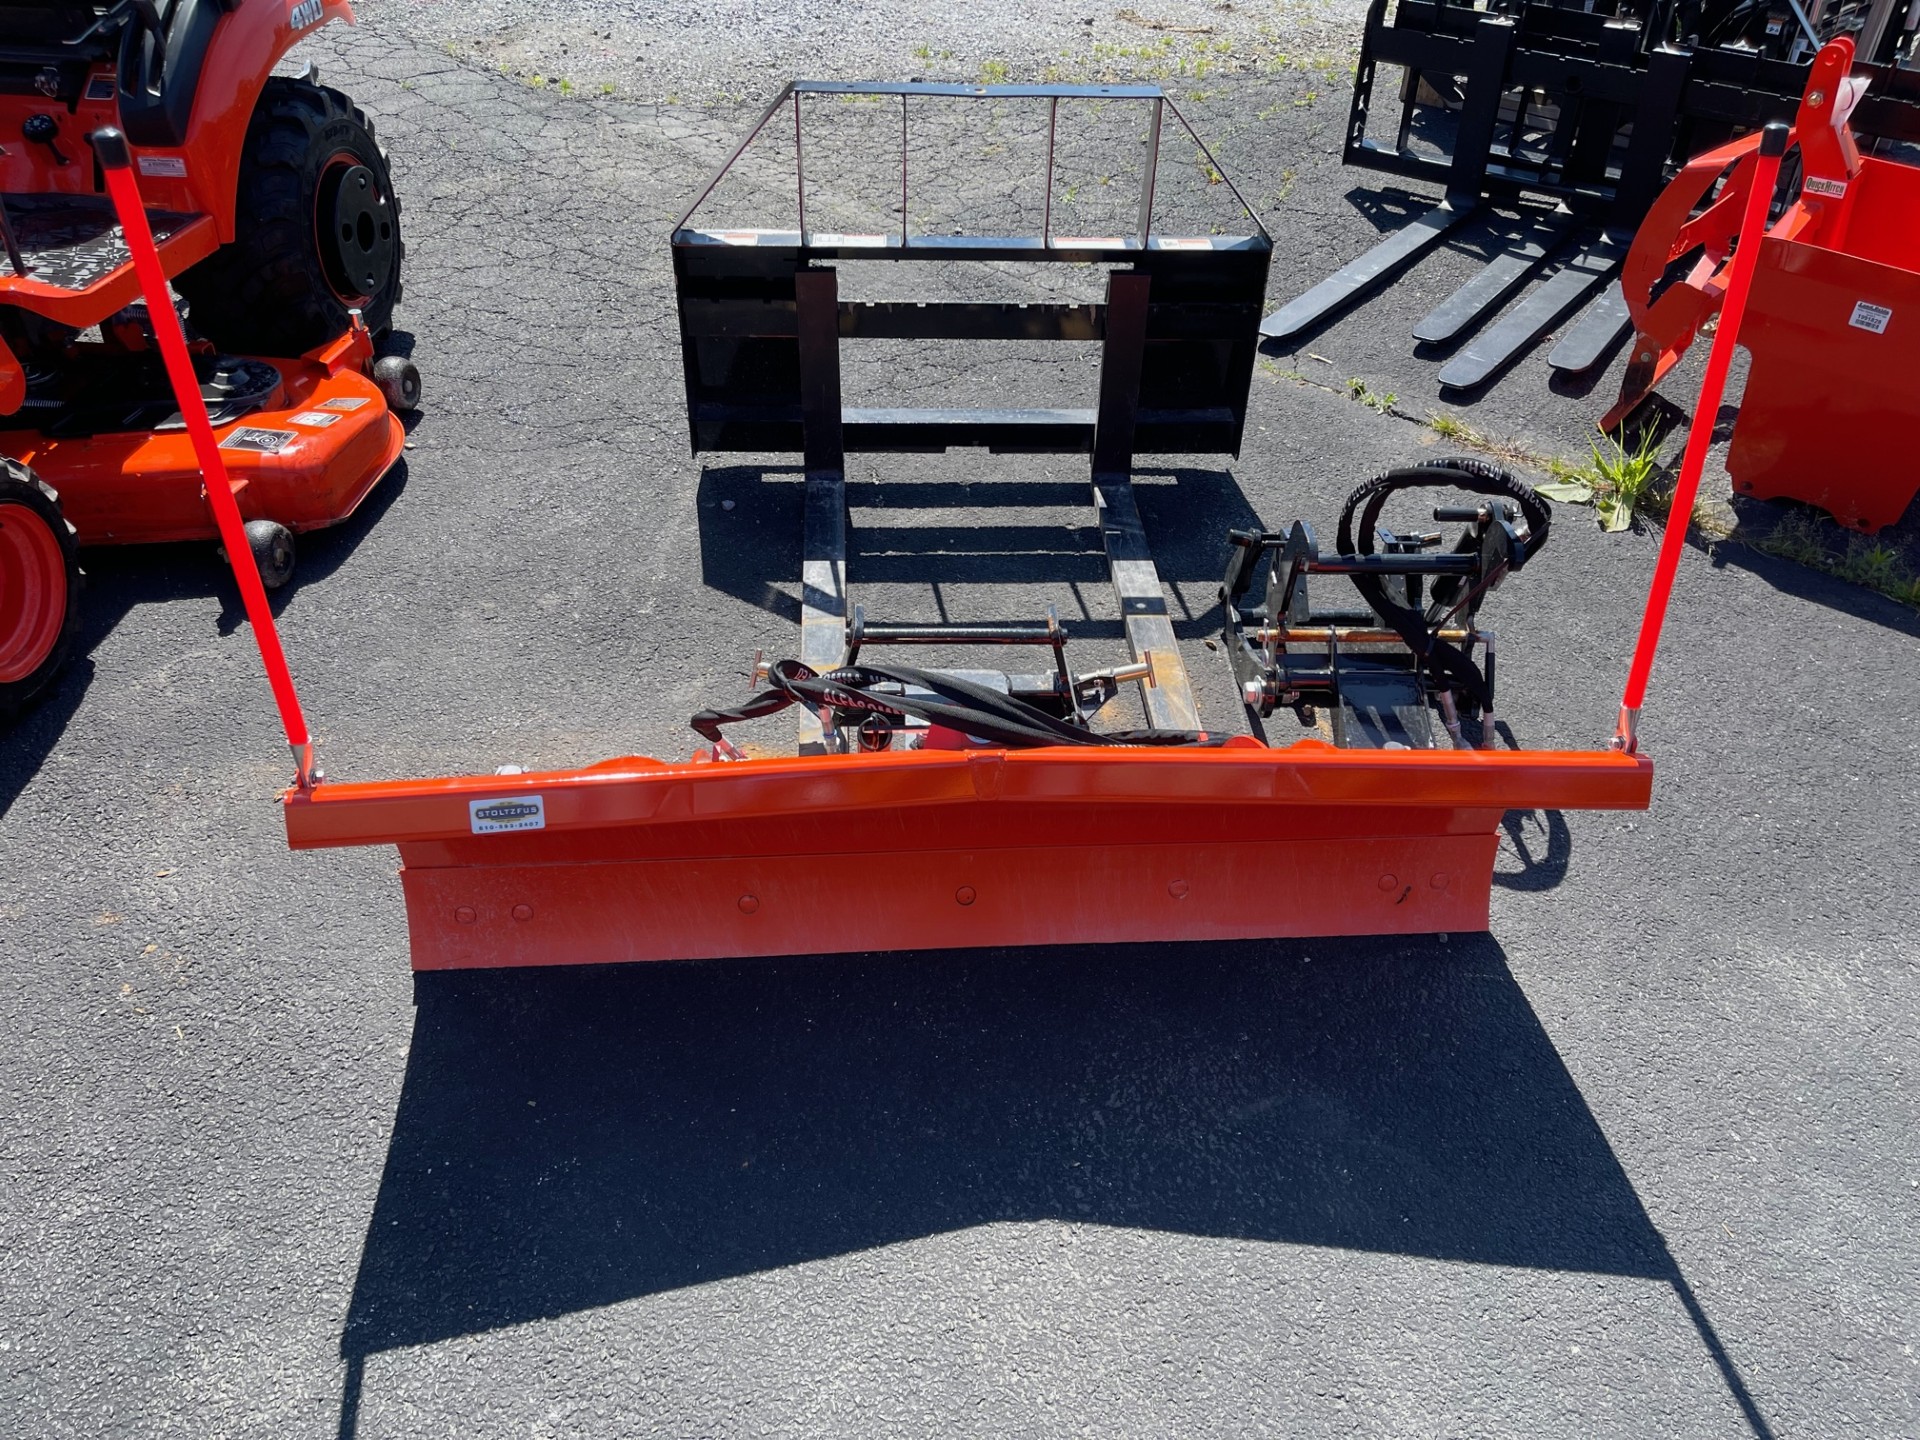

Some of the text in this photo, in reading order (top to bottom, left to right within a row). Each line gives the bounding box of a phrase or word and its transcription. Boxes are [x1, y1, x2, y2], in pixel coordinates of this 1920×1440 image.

[291, 0, 323, 30] 4WD
[1457, 460, 1503, 481] MSHA
[477, 806, 538, 818] STOLTZFUS
